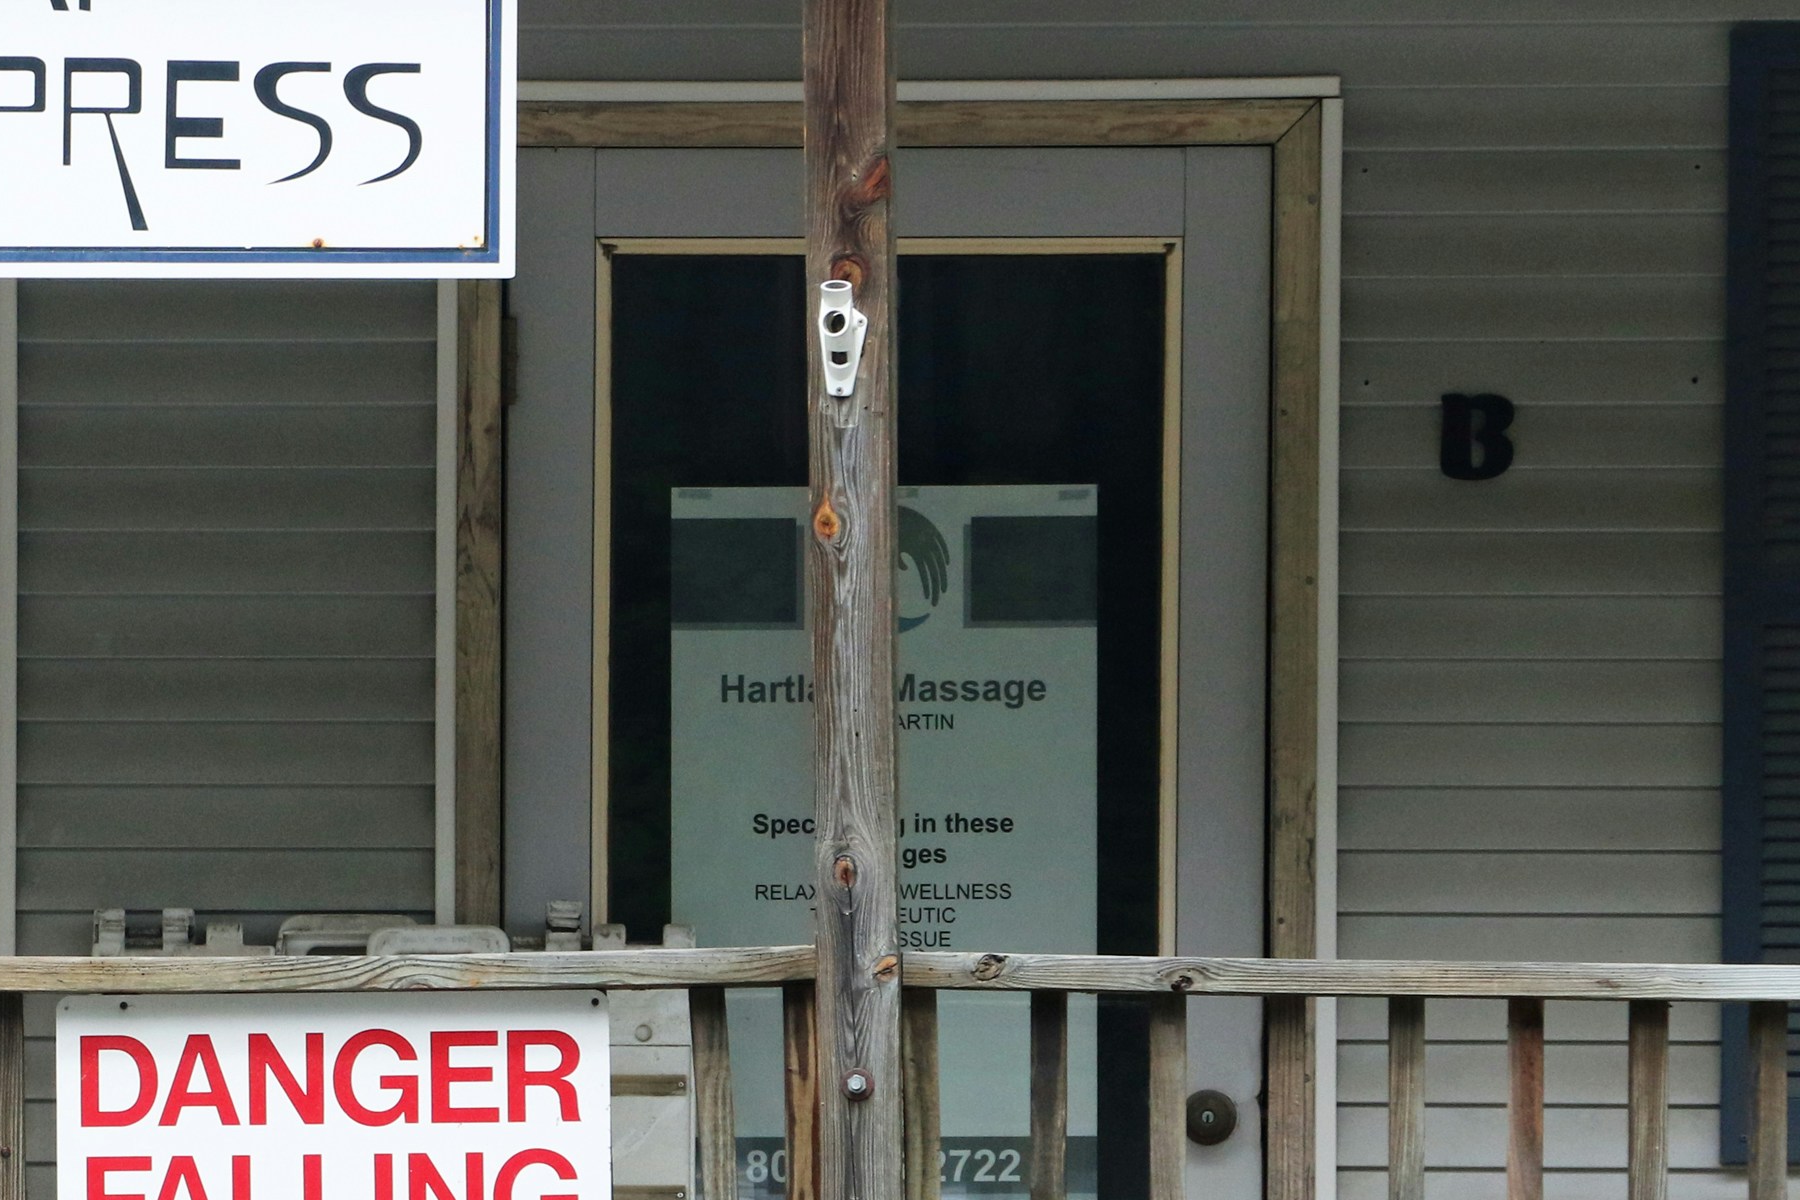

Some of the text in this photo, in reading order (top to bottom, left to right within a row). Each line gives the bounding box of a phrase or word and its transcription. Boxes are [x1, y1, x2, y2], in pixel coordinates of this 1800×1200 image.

[1440, 393, 1515, 481] B
[720, 674, 814, 703] Hartl
[915, 814, 1014, 834] in these
[900, 883, 1012, 900] WELLNESS
[900, 931, 952, 947] SSUE
[80, 1028, 582, 1128] DANGER
